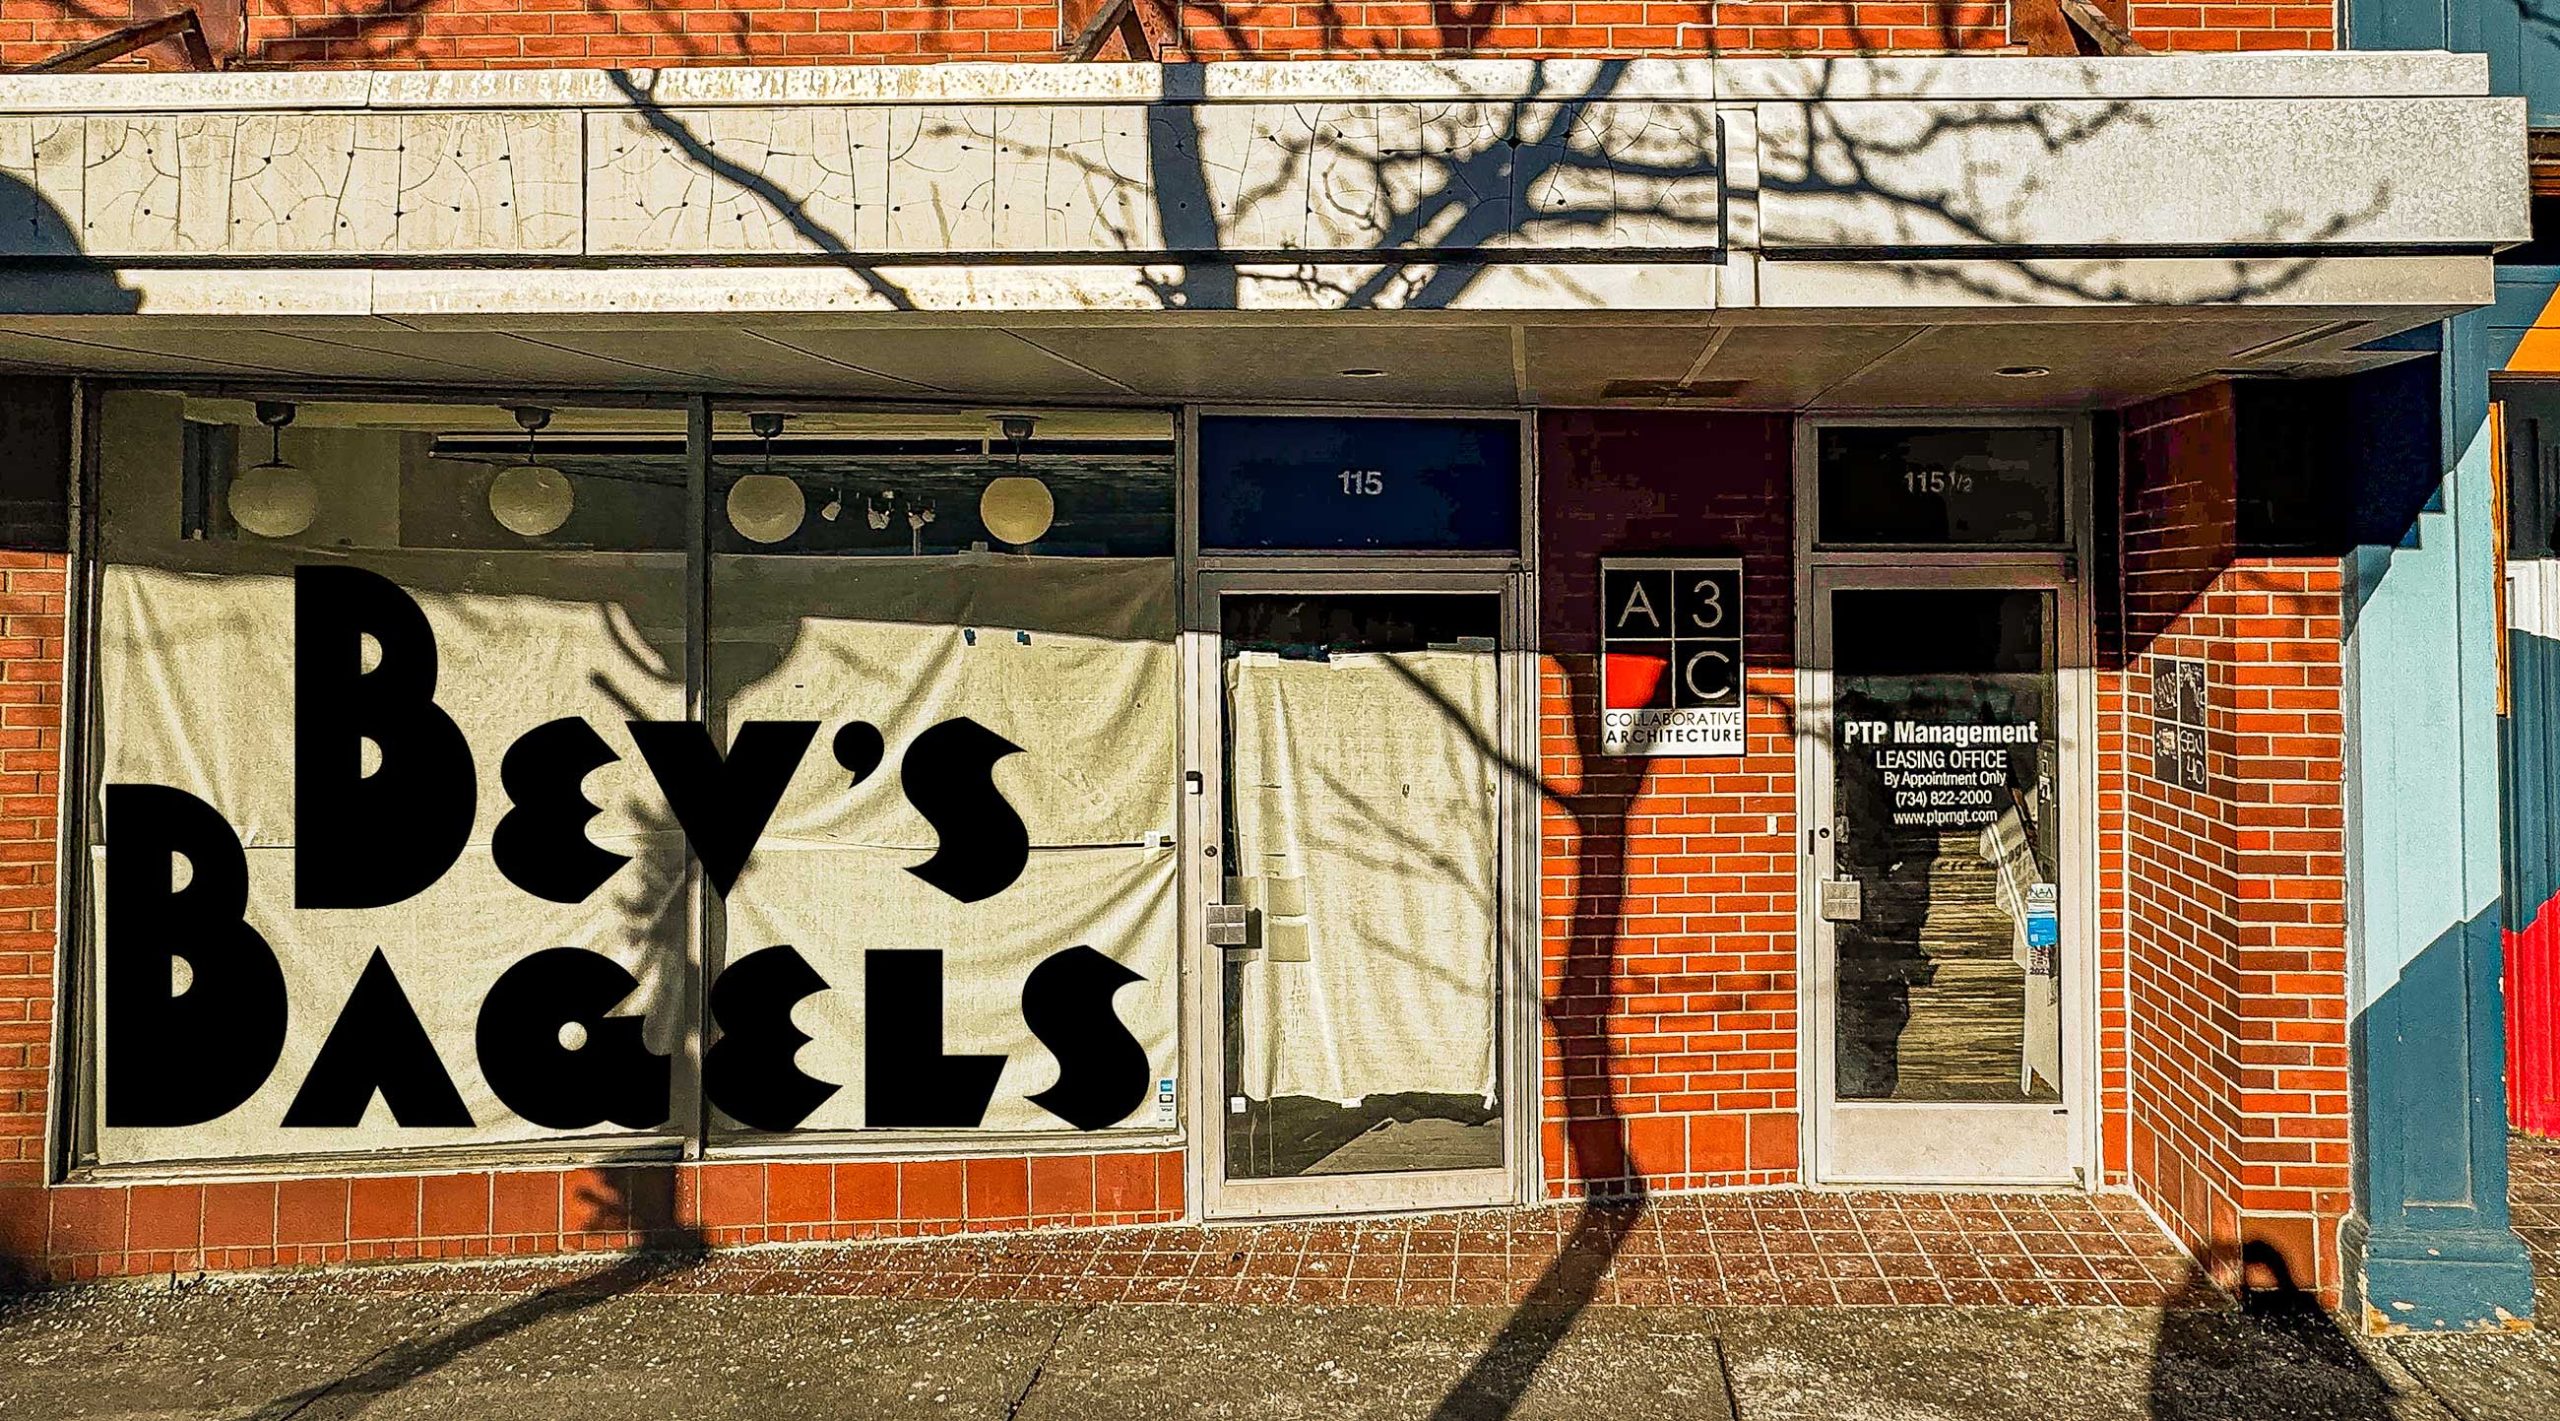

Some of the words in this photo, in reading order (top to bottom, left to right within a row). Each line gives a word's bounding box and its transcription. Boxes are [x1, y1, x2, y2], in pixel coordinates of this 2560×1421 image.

[1338, 470, 1383, 495] 115
[1617, 580, 1660, 628] A
[1692, 579, 1723, 629] 3
[1685, 650, 1731, 700] C
[1605, 711, 1741, 727] COLLABORATIVE
[1605, 728, 1742, 743] ARCHITECTURE
[1844, 720, 1888, 744] PTP
[1893, 720, 2039, 748] Management
[1876, 750, 1945, 768] LEASING
[1950, 750, 2008, 768] OFFICE
[1884, 771, 1900, 788] By
[1901, 771, 1978, 788] Appointment
[1980, 770, 2006, 787] Only
[1895, 790, 1928, 808] (734)
[1930, 790, 1993, 806] 822-2000
